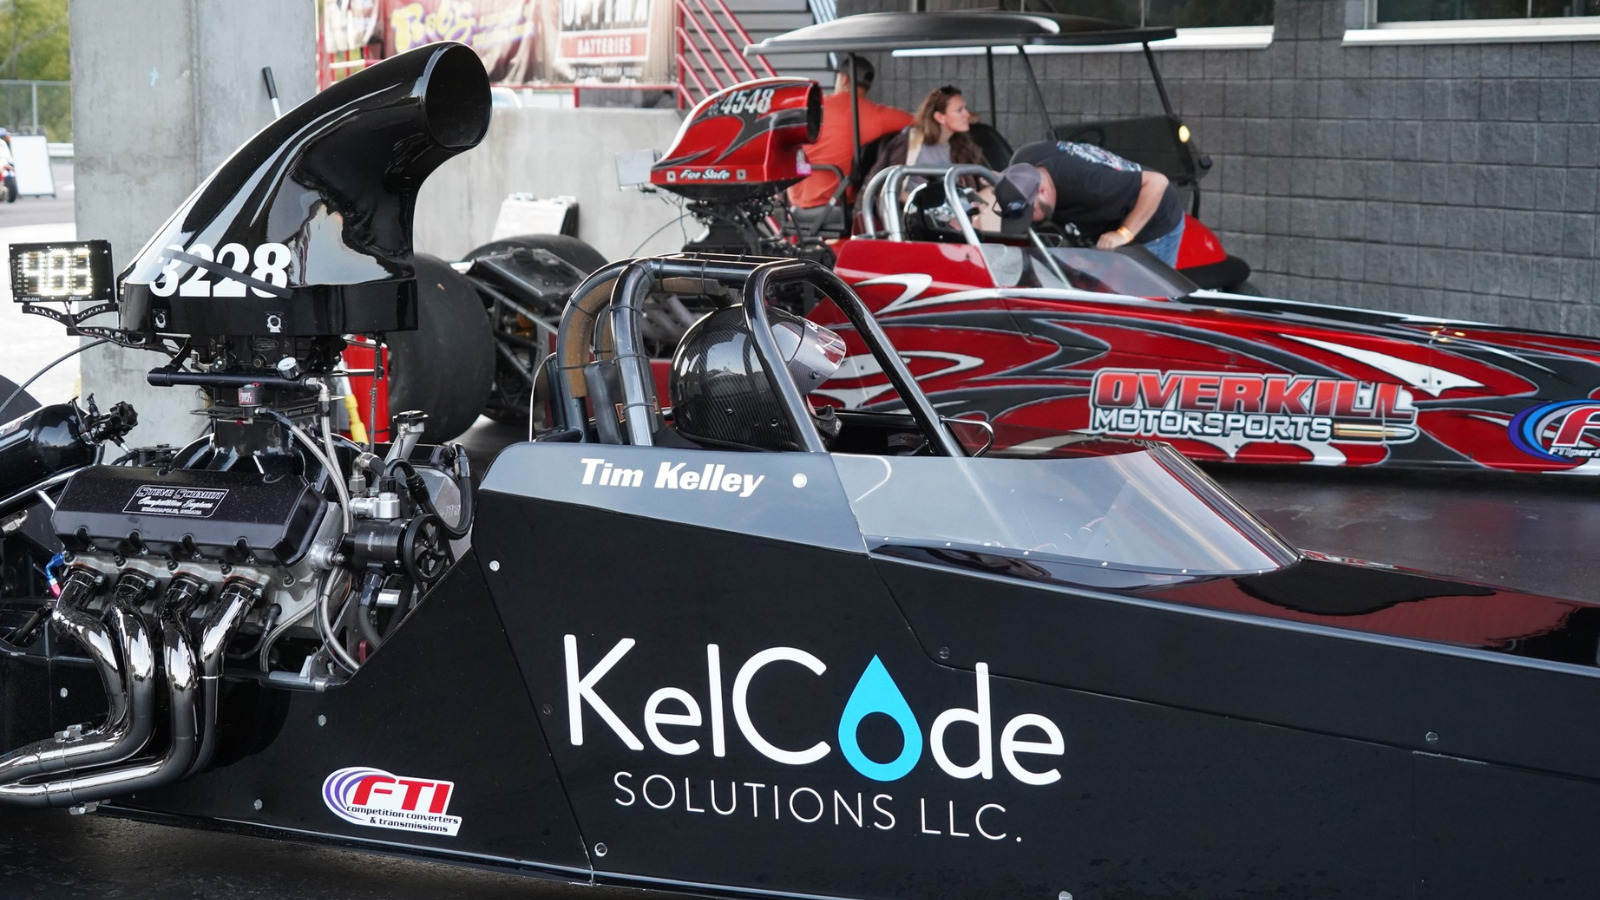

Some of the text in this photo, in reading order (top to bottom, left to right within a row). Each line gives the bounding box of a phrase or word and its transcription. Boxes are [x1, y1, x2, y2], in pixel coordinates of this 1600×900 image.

[577, 36, 632, 55] BATTERIES
[720, 88, 775, 115] 4548
[680, 168, 731, 180] For Sale
[1096, 371, 1416, 419] OVERKILL
[1092, 408, 1333, 440] MOTORSPORTS
[580, 457, 765, 498] Tim Kelley
[563, 633, 1066, 786] KelCode
[352, 775, 451, 814] FTI
[614, 771, 1022, 843] SOLUTIONS LLC.
[346, 805, 459, 825] competition converters
[369, 816, 449, 833] & transmissions
